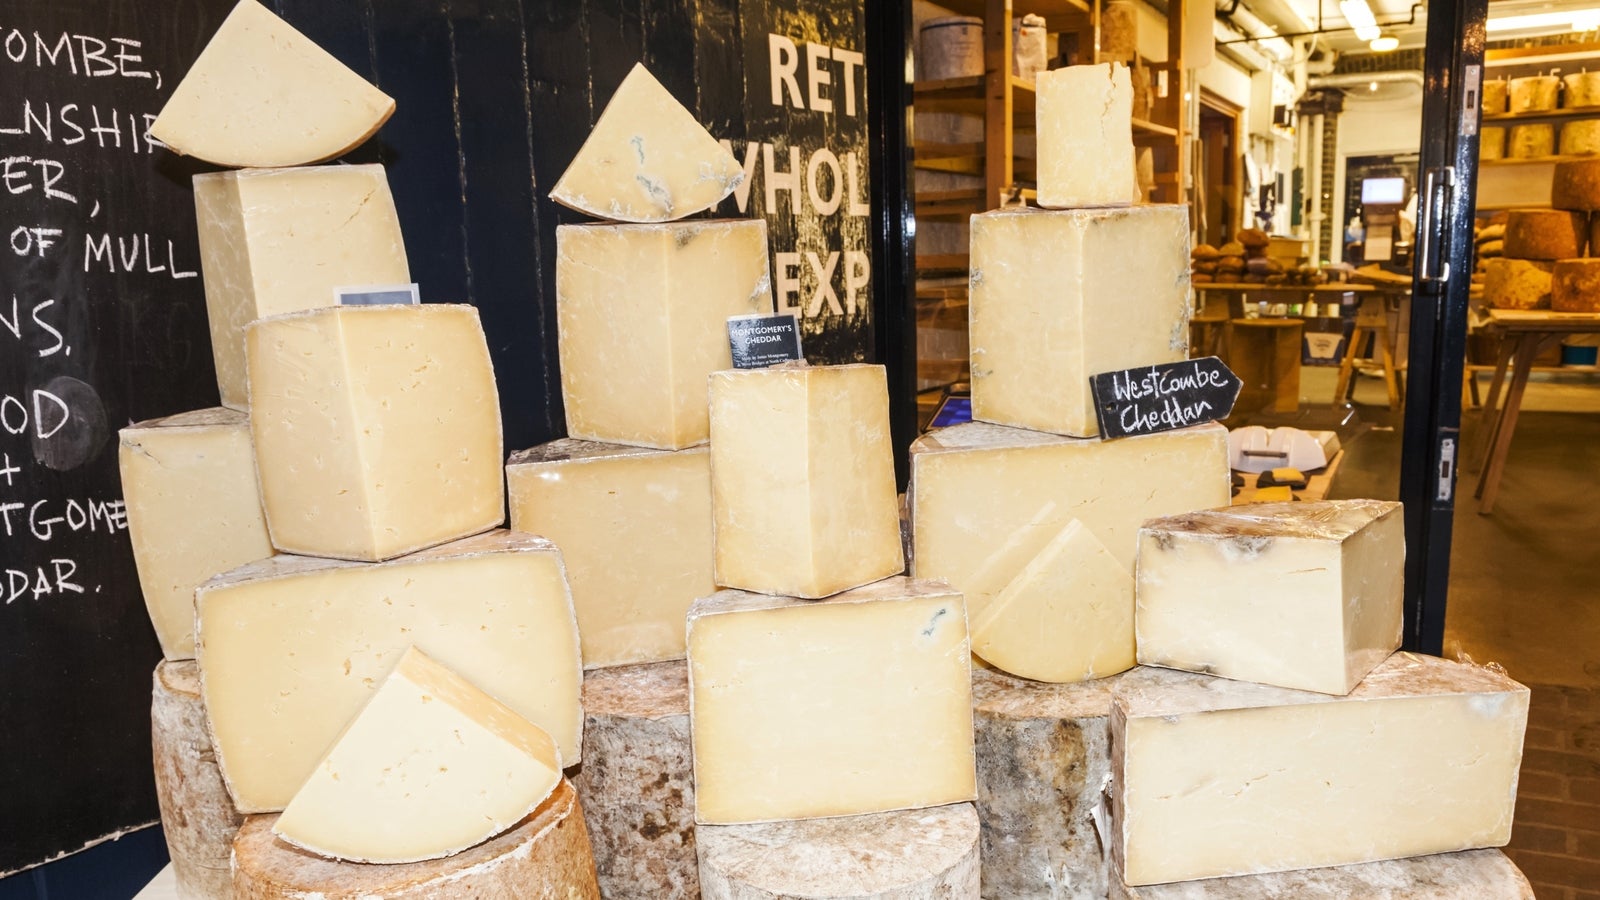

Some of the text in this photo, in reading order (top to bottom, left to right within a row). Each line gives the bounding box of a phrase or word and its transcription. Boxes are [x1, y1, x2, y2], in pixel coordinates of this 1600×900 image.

[0, 27, 162, 90] OMBE,
[768, 32, 864, 117] RET
[10, 225, 197, 278] OF MULL
[775, 250, 871, 319] EXP
[731, 325, 792, 337] MONTGOMERY'S
[745, 335, 782, 345] CHEDDAR
[1113, 363, 1229, 401] Westcombe
[0, 388, 70, 439] OD
[0, 558, 101, 604] DAR.
